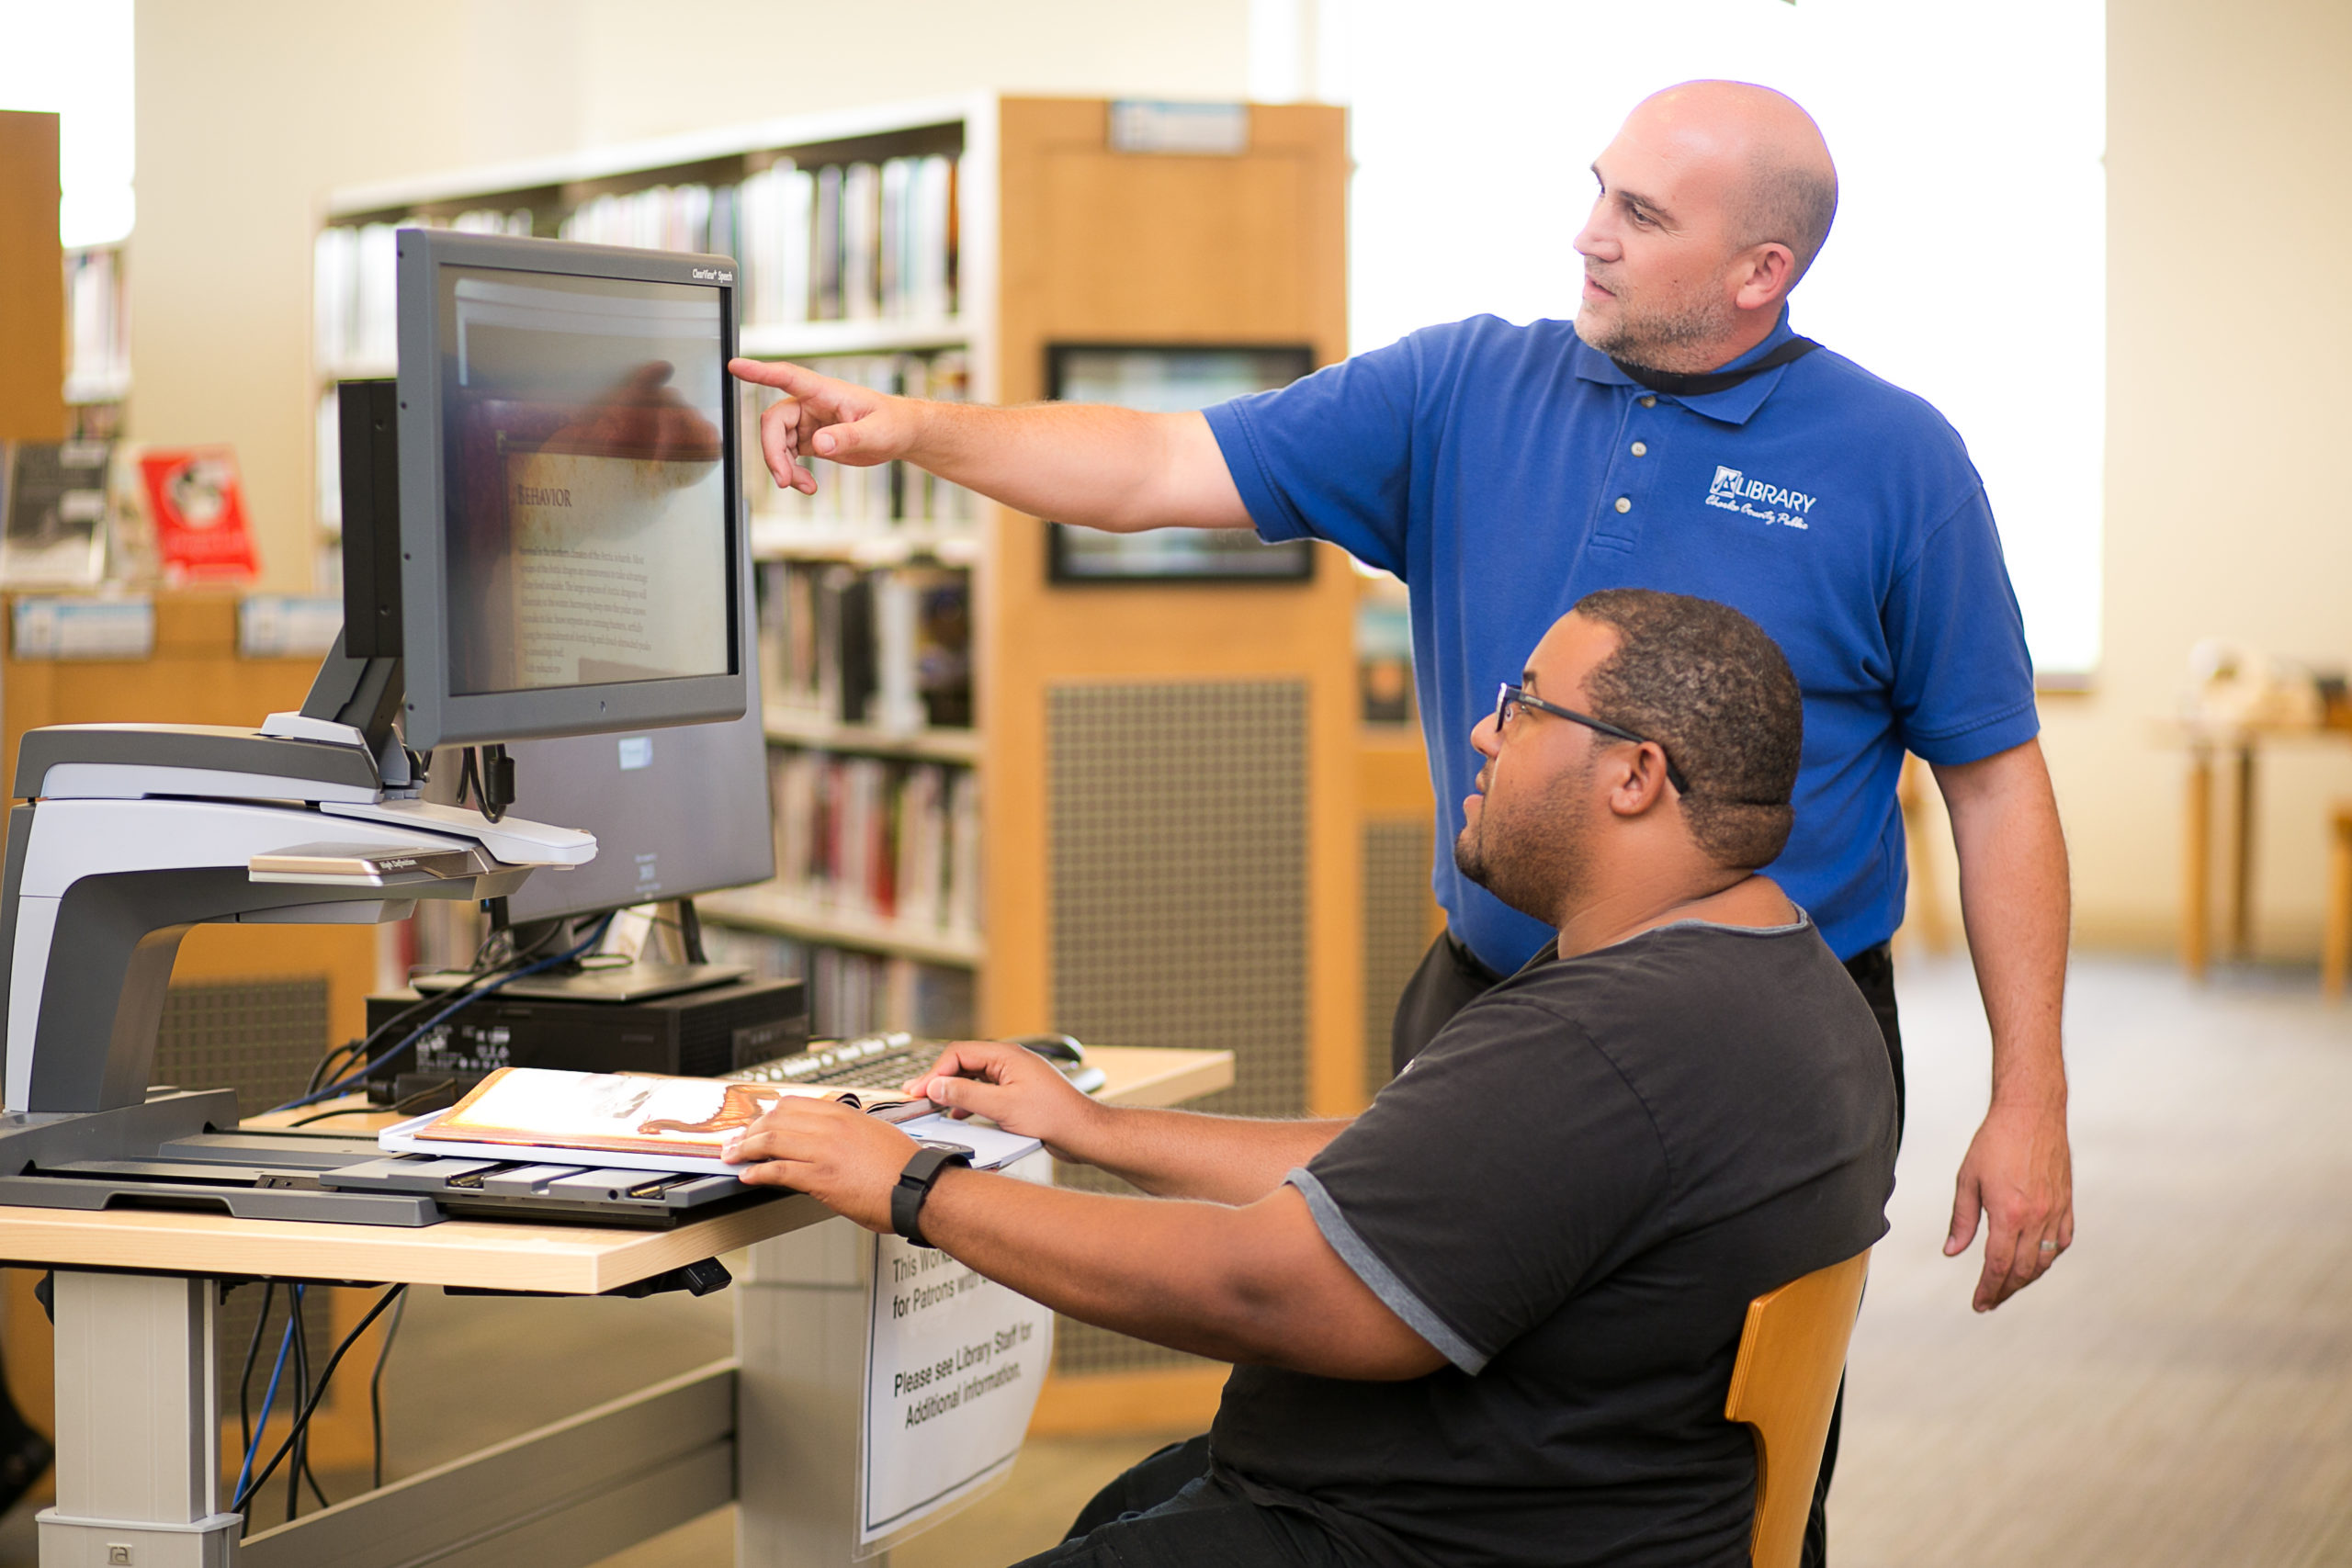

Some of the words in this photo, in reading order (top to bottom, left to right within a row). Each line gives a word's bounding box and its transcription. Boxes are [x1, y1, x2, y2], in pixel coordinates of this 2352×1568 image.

[718, 270, 733, 284] Speech
[1735, 476, 1817, 513] LIBRARY
[1740, 502, 1776, 525] County
[1776, 512, 1808, 530] Public
[892, 1254, 918, 1283] This
[919, 1248, 953, 1272] Work
[892, 1294, 910, 1319] for
[913, 1280, 955, 1312] Patrons
[894, 1366, 933, 1398] Please
[935, 1357, 954, 1381] see
[956, 1342, 991, 1371] Library
[994, 1324, 1017, 1354] Staff
[1020, 1321, 1034, 1343] for
[905, 1383, 961, 1429] Additional
